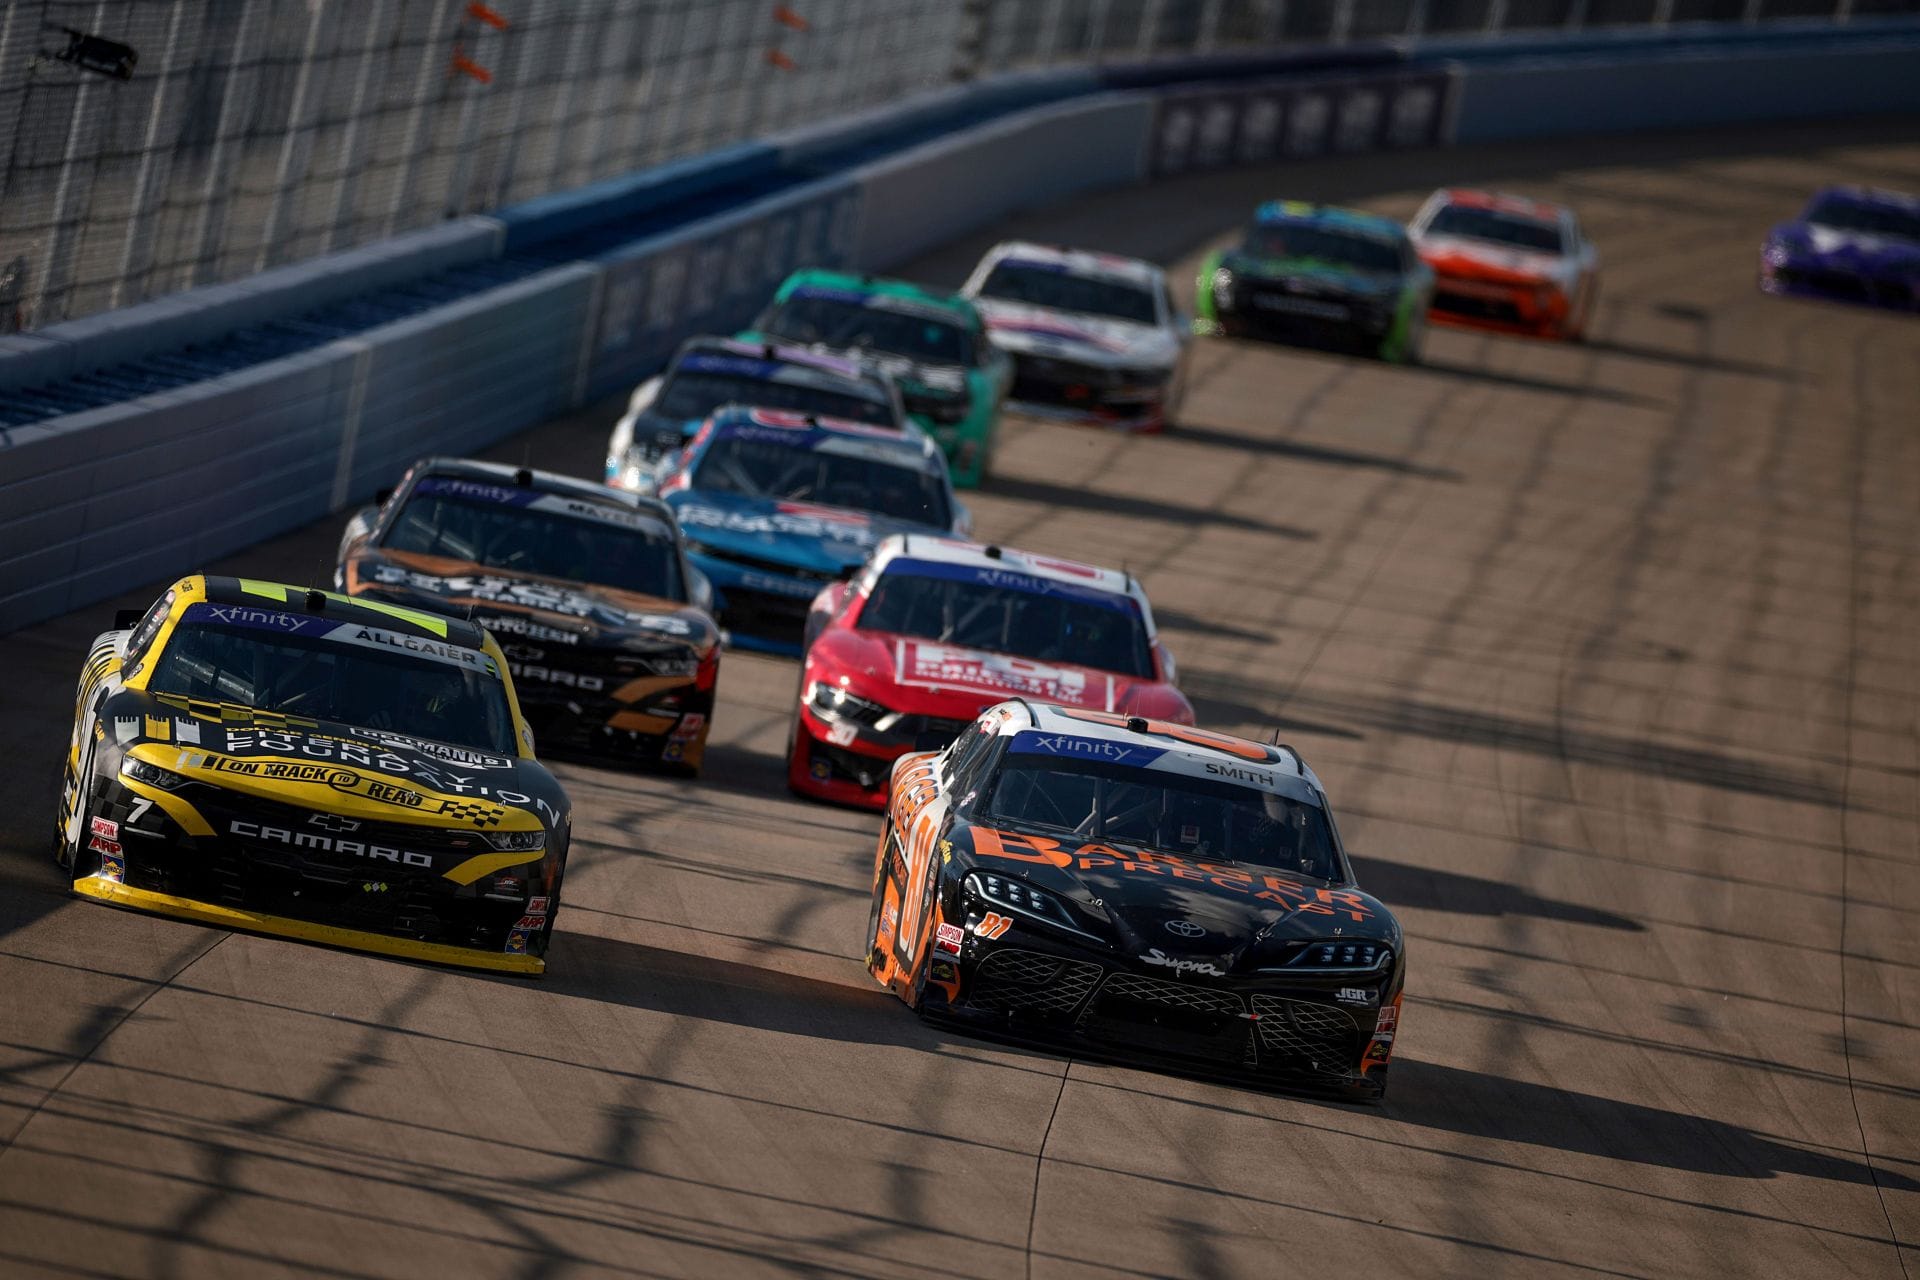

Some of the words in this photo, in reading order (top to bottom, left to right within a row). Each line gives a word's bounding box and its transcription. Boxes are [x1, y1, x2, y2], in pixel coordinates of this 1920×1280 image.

[436, 480, 517, 502] xfinity
[976, 570, 1053, 594] xfinity
[209, 607, 308, 631] xfinity
[355, 630, 476, 664] ALLGAIER
[225, 727, 303, 737] DOLLAR
[308, 733, 396, 753] GENERAL
[1036, 736, 1132, 760] xfinity
[226, 731, 476, 783] LITERACY
[226, 740, 560, 828] FOUNDATION
[229, 762, 259, 774] ON
[263, 764, 331, 781] TRACK
[338, 774, 350, 783] TO
[368, 782, 423, 807] READ
[1205, 763, 1275, 786] SMITH
[127, 797, 154, 823] 7
[94, 820, 116, 837] SIMPSON
[91, 837, 121, 854] ARP
[230, 820, 432, 867] CAMARO
[968, 826, 1374, 912] BARGER
[1079, 857, 1375, 922] PRECAST
[939, 924, 963, 942] SIMPSON
[974, 911, 1014, 940] 81
[1139, 948, 1225, 978] Supra
[1335, 988, 1367, 1001] JGR
